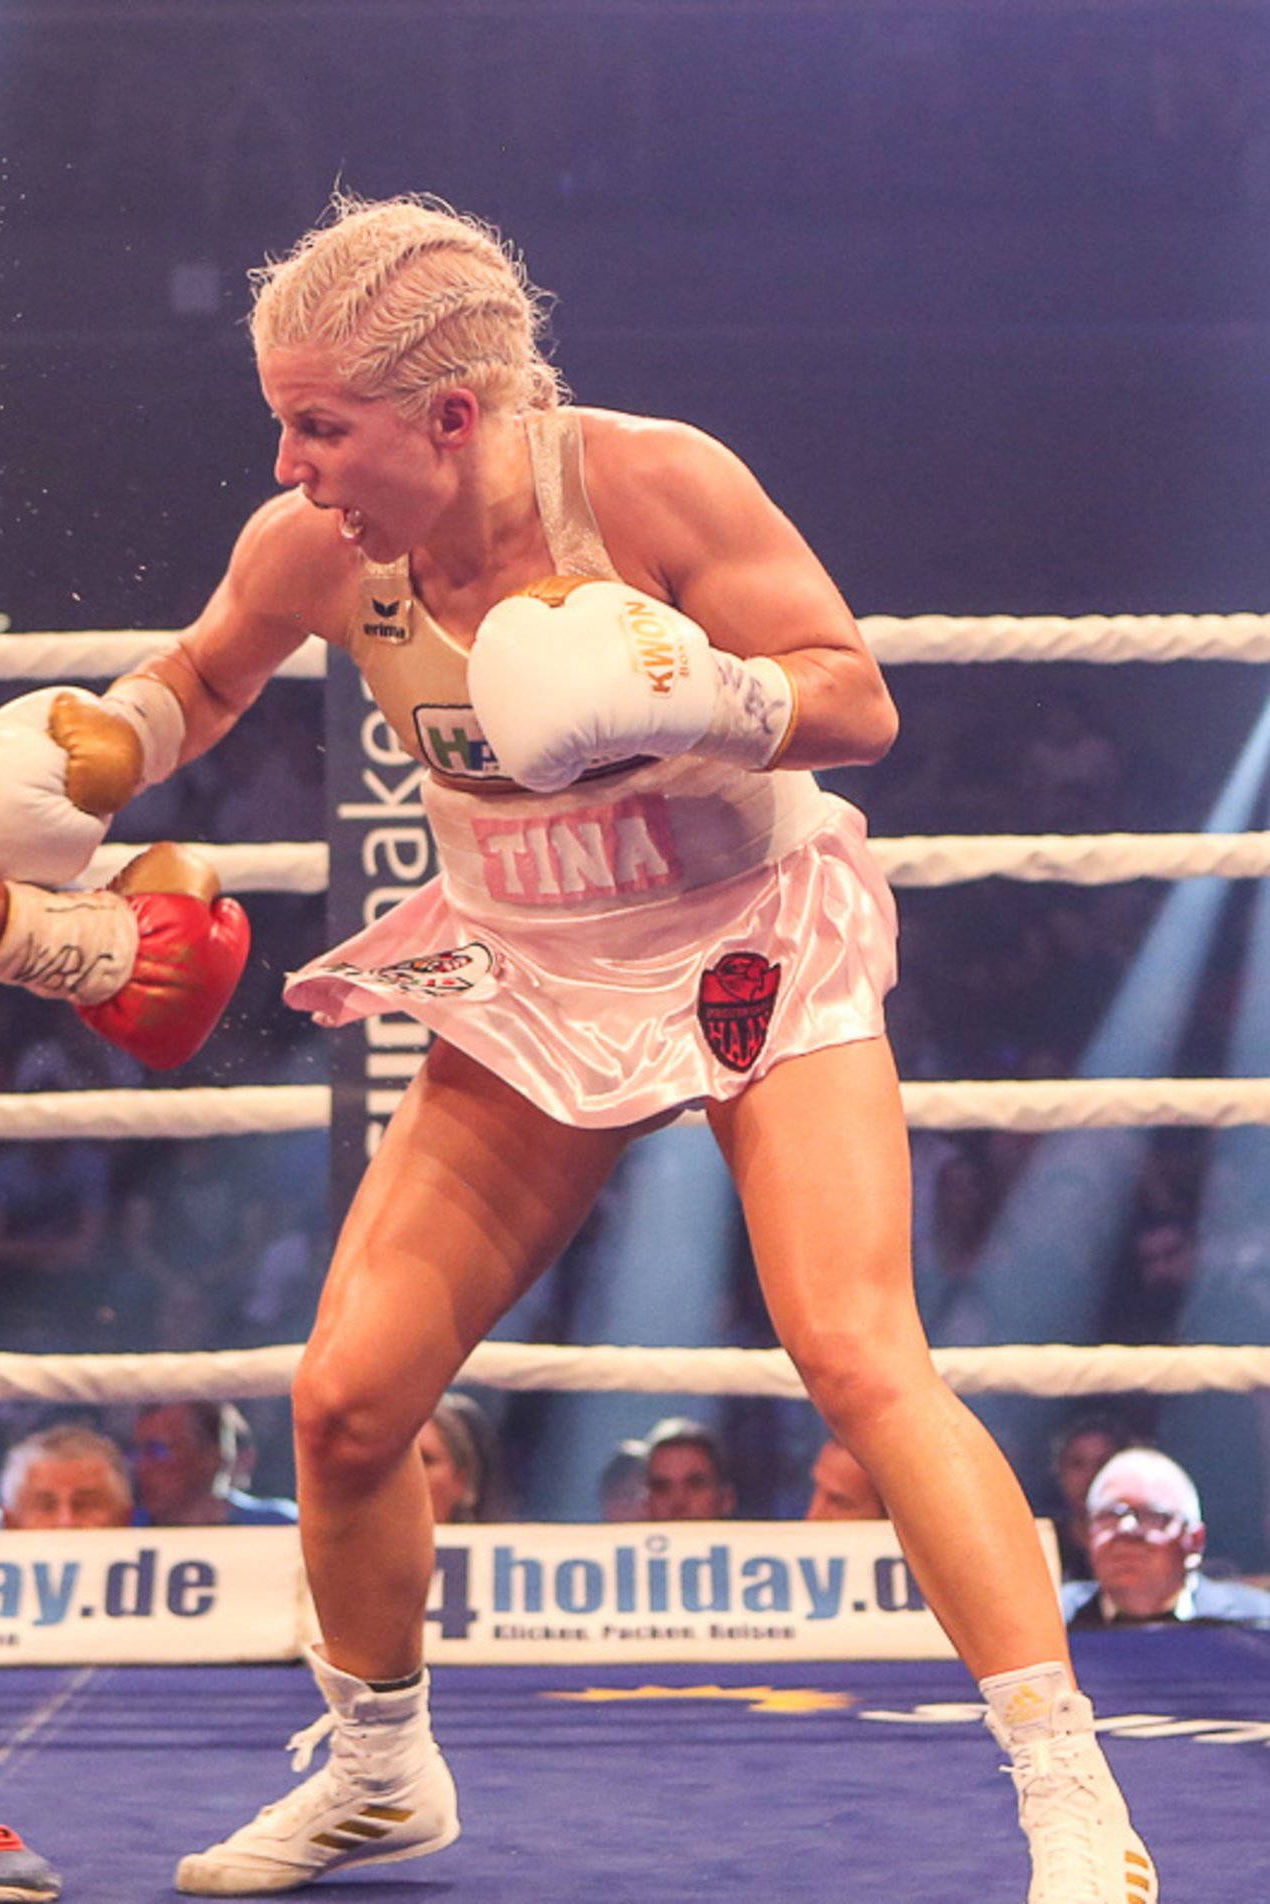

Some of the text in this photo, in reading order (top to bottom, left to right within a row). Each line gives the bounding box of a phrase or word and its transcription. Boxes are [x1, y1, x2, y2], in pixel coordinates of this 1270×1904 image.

[363, 622, 405, 639] erima
[624, 601, 674, 694] KWON
[488, 815, 671, 896] TINA
[425, 1535, 930, 1640] 4holiday.d
